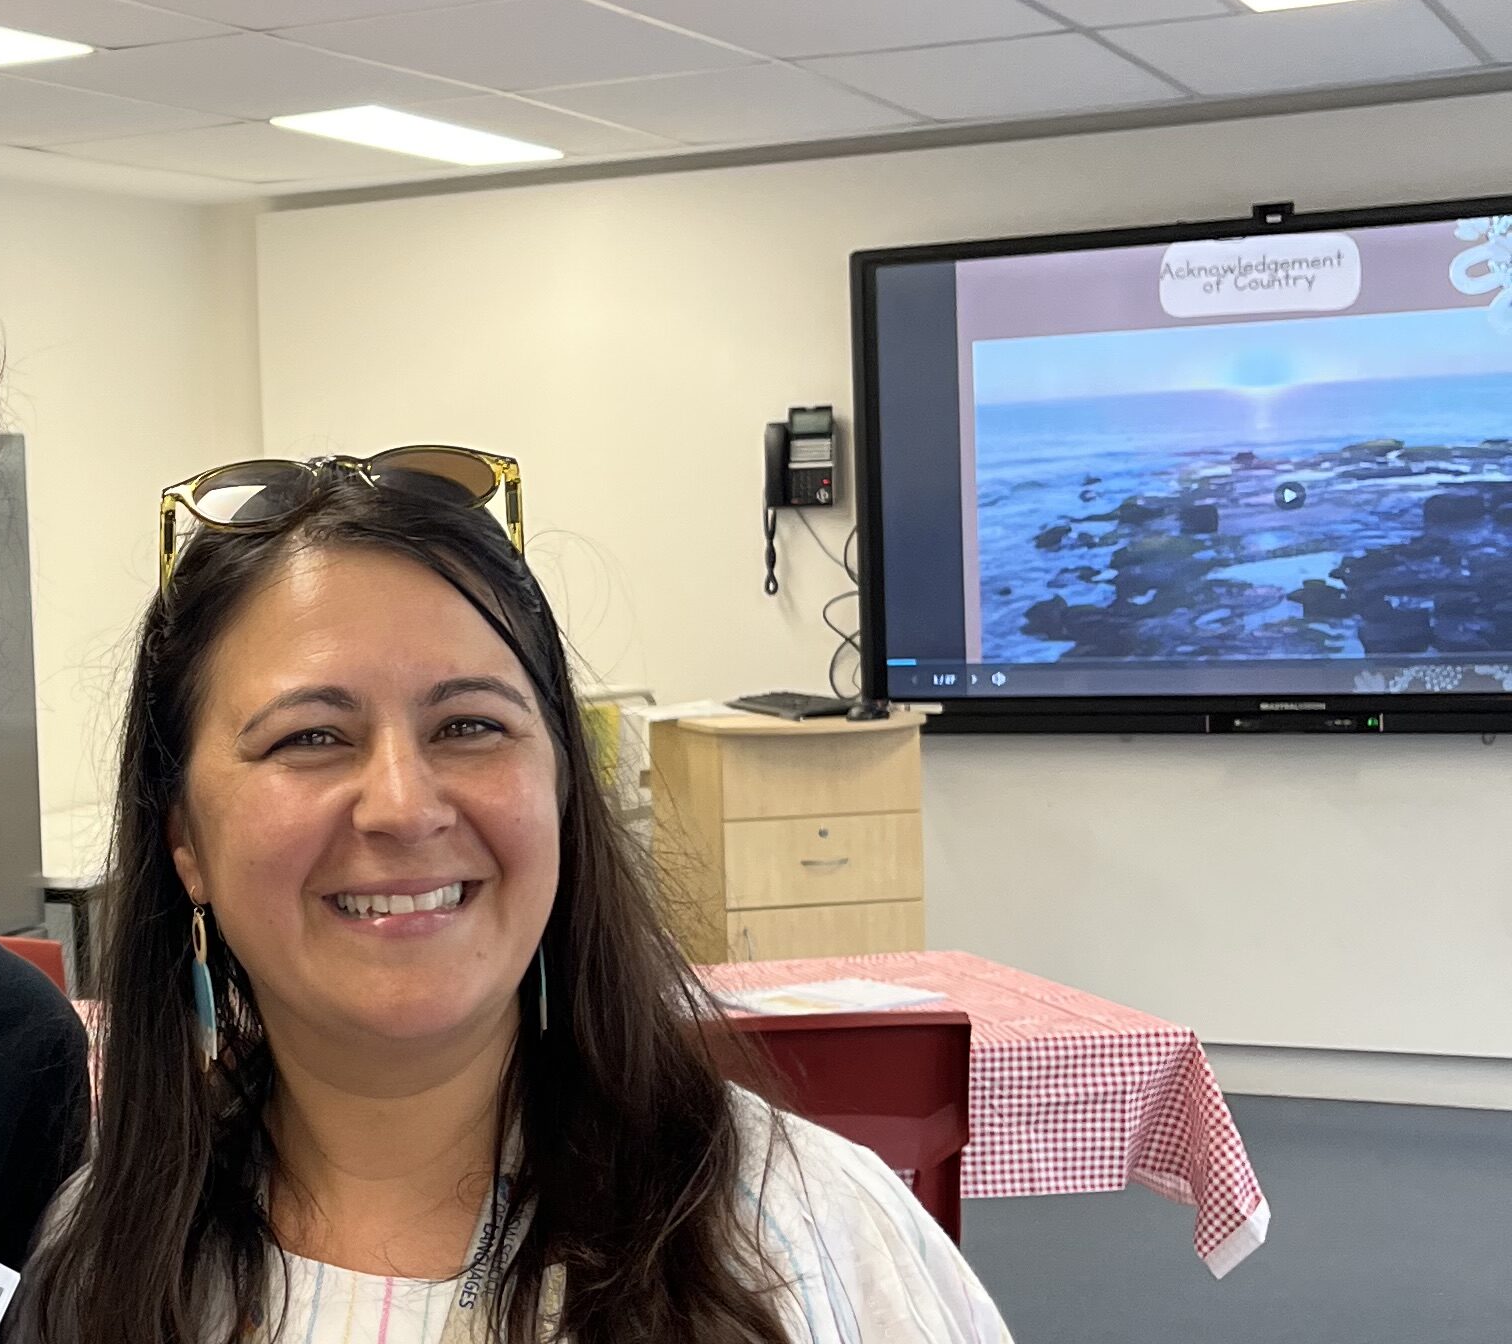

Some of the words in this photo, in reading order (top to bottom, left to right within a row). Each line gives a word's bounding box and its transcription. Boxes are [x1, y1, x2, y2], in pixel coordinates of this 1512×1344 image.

[1160, 250, 1345, 280] Acknowledgement
[1202, 277, 1221, 294] of
[1234, 273, 1316, 293] Country
